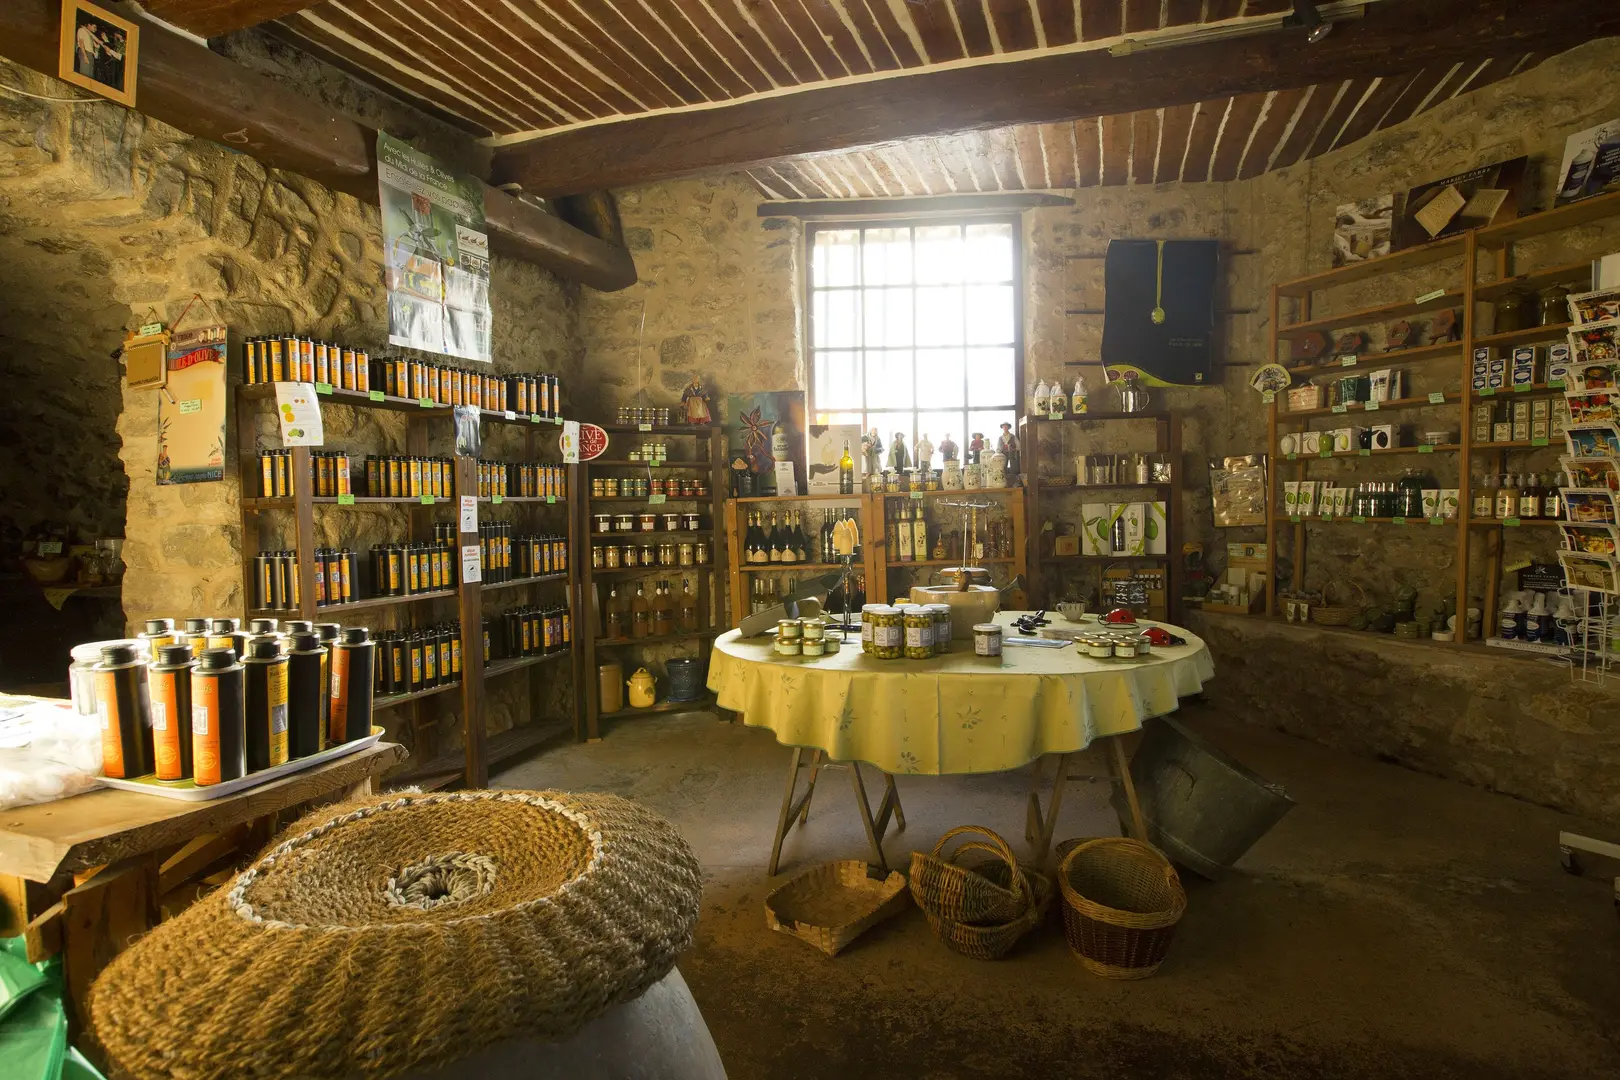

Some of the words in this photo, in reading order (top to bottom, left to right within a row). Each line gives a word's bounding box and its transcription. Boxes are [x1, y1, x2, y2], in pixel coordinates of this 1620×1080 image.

[383, 142, 401, 157] Avec
[402, 151, 410, 163] les
[384, 154, 394, 165] du
[408, 167, 418, 177] de
[427, 174, 448, 191] France
